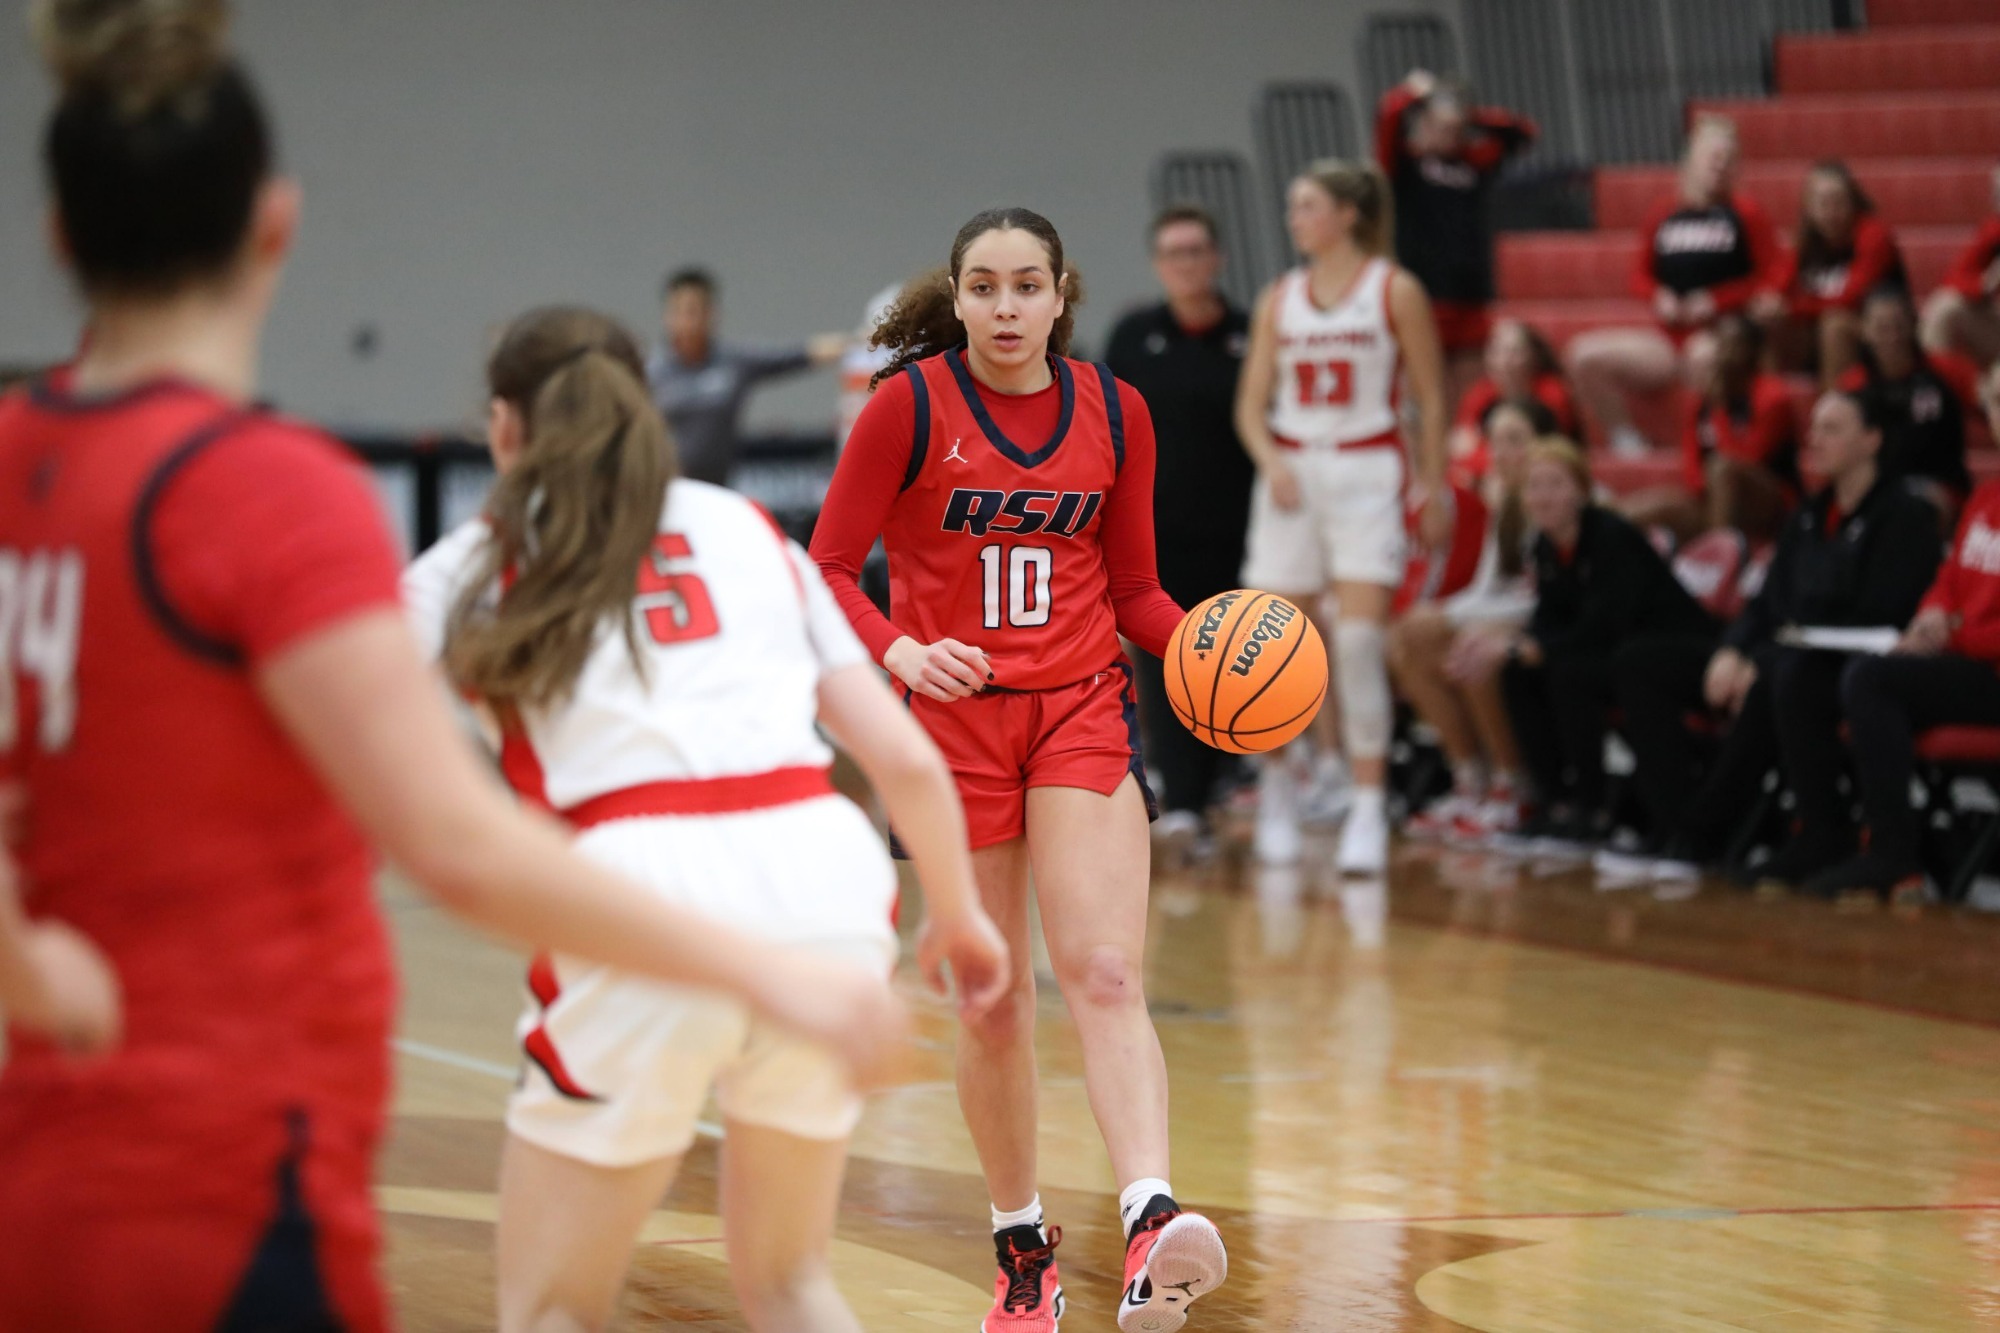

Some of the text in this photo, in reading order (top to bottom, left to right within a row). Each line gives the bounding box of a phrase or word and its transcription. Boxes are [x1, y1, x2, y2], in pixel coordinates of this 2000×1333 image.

[941, 488, 1103, 539] RSU
[978, 544, 1053, 629] 10
[1193, 593, 1242, 651] NCAA
[1229, 599, 1297, 677] Wilson
